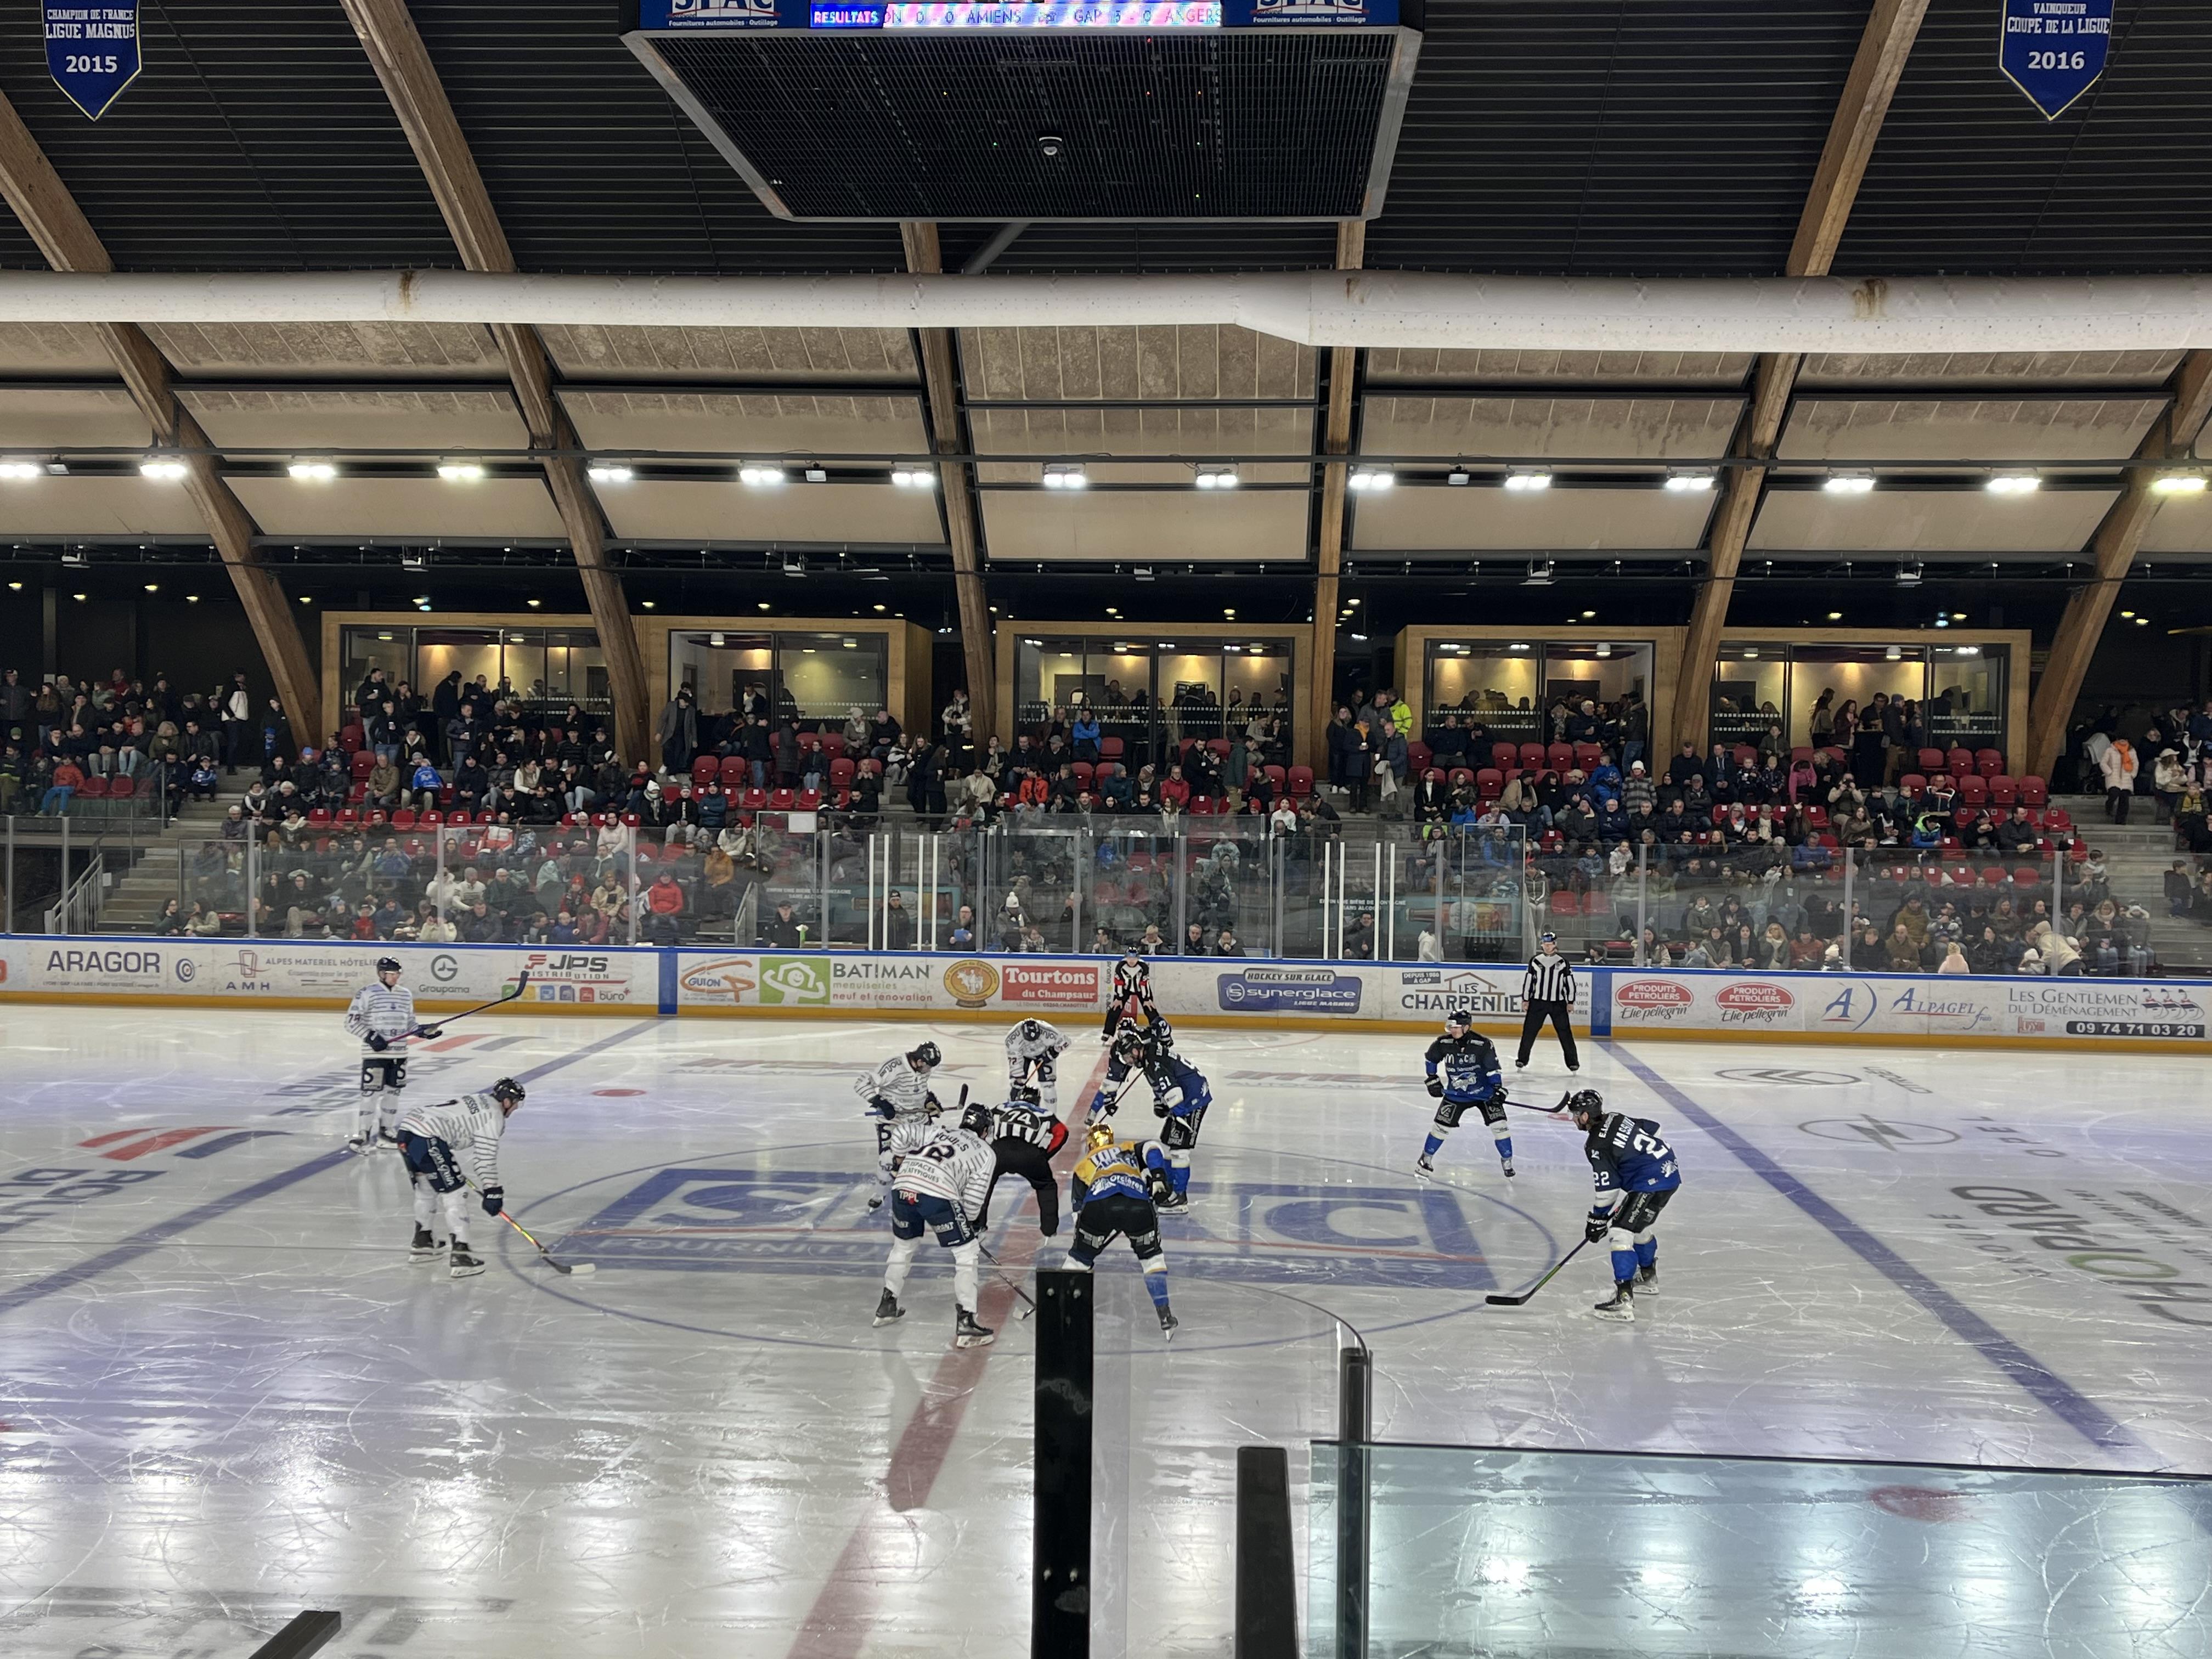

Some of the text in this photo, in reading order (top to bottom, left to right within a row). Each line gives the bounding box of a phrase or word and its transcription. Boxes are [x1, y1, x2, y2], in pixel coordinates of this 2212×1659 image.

[47, 9, 134, 20] CHAMPION DE FRANCE
[1074, 8, 1103, 23] GAP
[2034, 3, 2086, 14] VAINQUEUR
[814, 10, 878, 24] RESULTATS
[968, 9, 1022, 24] AMIENS
[45, 24, 134, 39] LIGUE MAGNUS
[2007, 16, 2110, 34] COUPE DE LA LIGUE
[65, 55, 118, 72] 2015
[2028, 52, 2085, 69] 2016
[47, 951, 160, 973] ARAGOR
[340, 957, 378, 967] HÔTELIE
[549, 955, 608, 972] JPS
[689, 978, 721, 987] GUION
[1005, 967, 1096, 985] Tourtons
[419, 984, 470, 995] Groupama
[833, 981, 898, 989] menuiseries
[1459, 983, 1479, 994] LES
[833, 992, 856, 1001] neuf
[874, 993, 933, 1001] rénovation
[1022, 989, 1096, 1001] du Champsaur
[1246, 988, 1356, 1000] synerglace
[1628, 992, 1680, 1000] PETROLIERS
[1729, 995, 1781, 1003] PETROLIERS
[1402, 993, 1524, 1012] CHARPENTIE
[1642, 1003, 1687, 1021] pellegrin
[1742, 1006, 1788, 1023] pellegrin
[2076, 1023, 2196, 1036] 09 74 71 03 20
[1158, 1076, 1172, 1090] 51
[1957, 1115, 2068, 1158] OPEL
